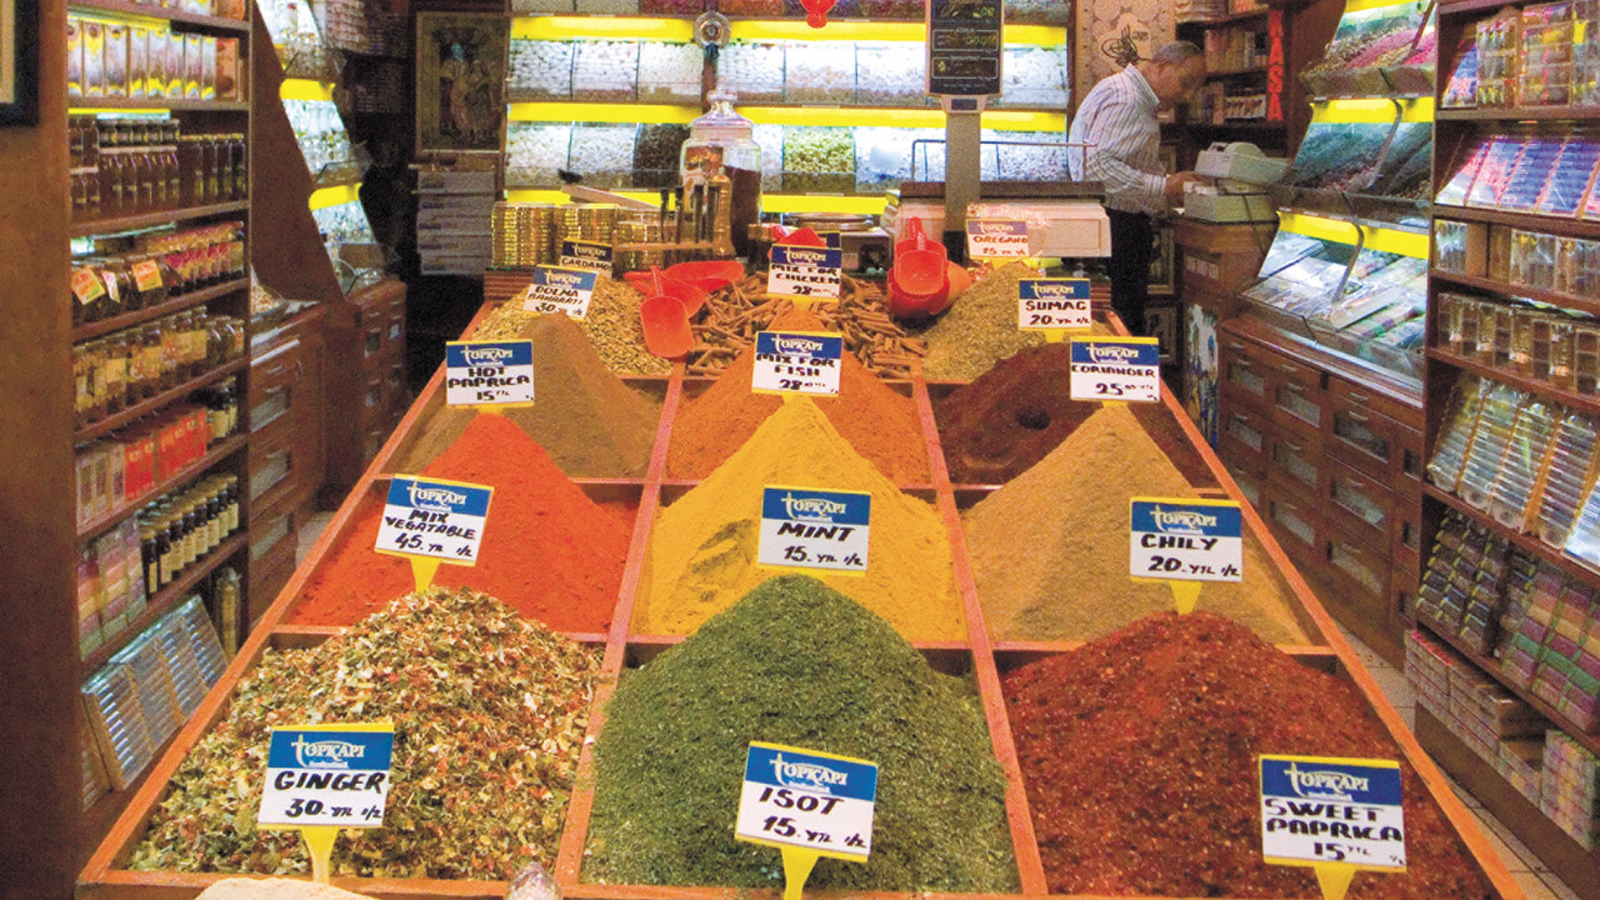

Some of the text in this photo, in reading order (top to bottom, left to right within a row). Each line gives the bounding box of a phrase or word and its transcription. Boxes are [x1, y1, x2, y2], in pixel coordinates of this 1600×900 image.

[1267, 9, 1284, 121] KASA
[973, 235, 1029, 244] OREGANO
[535, 286, 579, 298] DOLMA
[1025, 300, 1087, 312] SUMAC
[756, 353, 792, 364] MIX
[468, 367, 506, 378] HOT
[774, 365, 820, 376] FISH
[1071, 365, 1156, 378] CORIANDER
[408, 509, 450, 523] MIX
[385, 516, 476, 540] VEGATABLE
[777, 522, 856, 542] MINT
[1140, 533, 1218, 551] CHILY
[274, 770, 386, 795] GINGER
[758, 787, 846, 815] ISOT
[1264, 798, 1385, 822] SWEET
